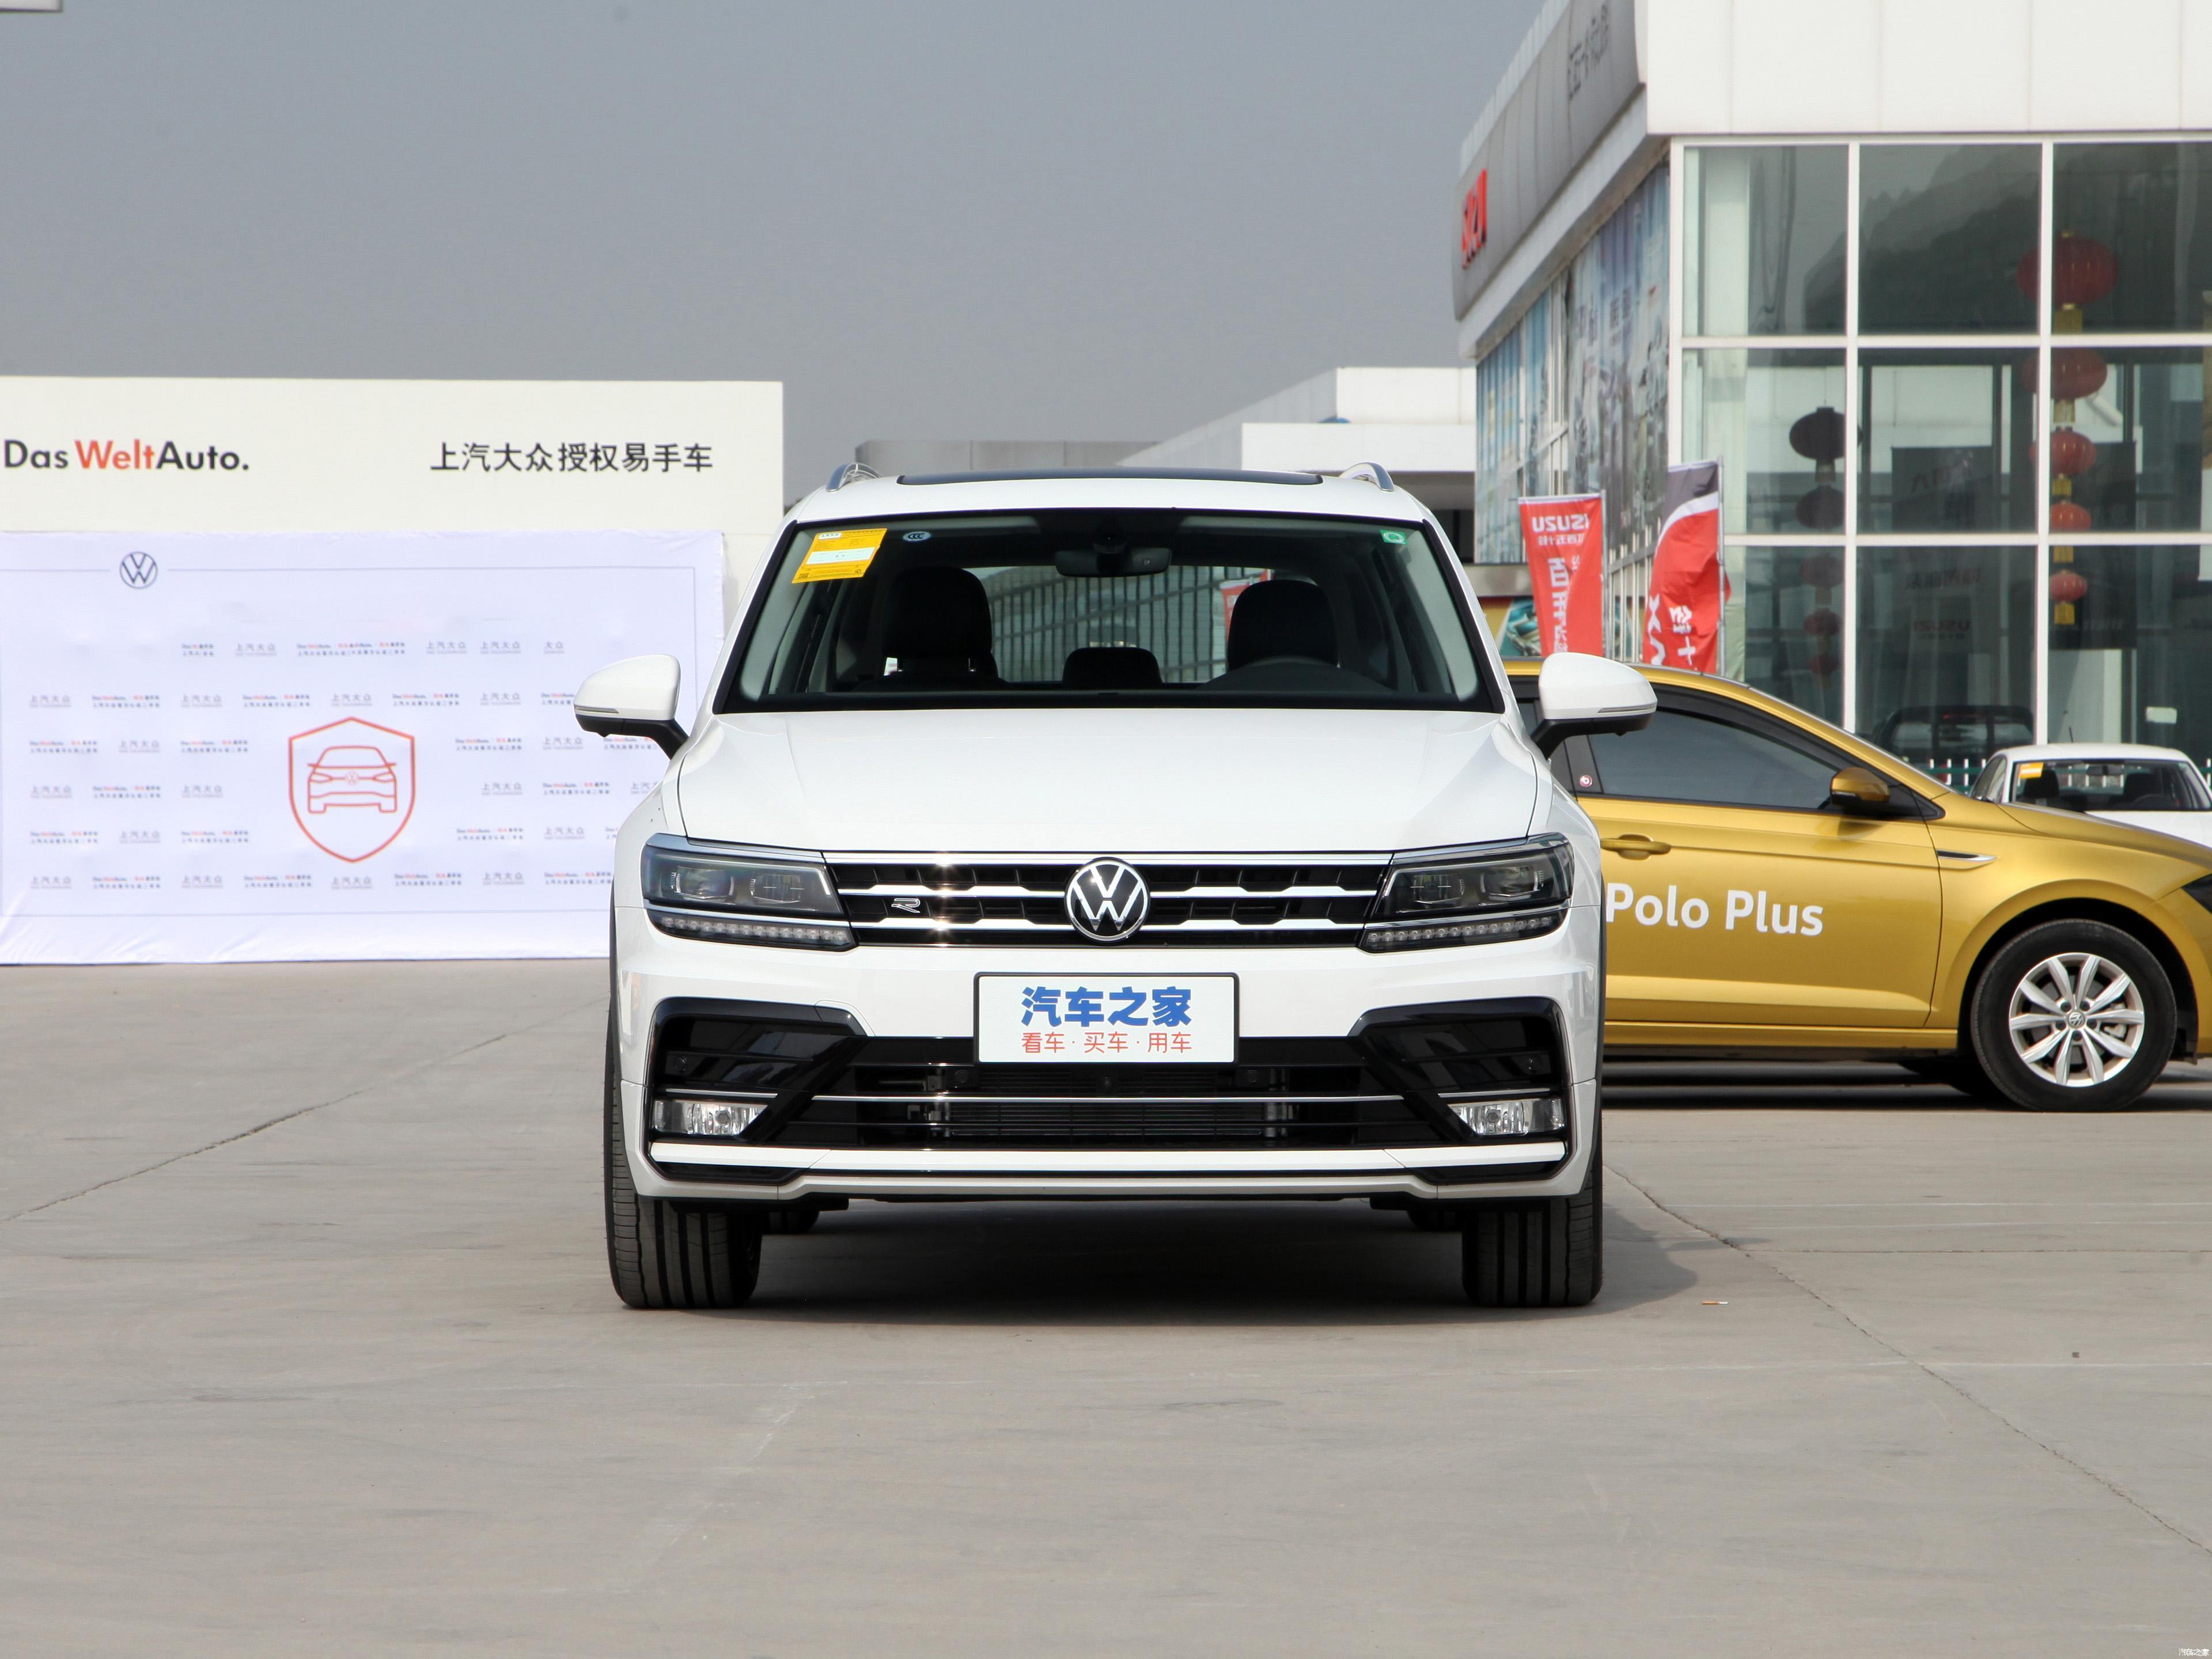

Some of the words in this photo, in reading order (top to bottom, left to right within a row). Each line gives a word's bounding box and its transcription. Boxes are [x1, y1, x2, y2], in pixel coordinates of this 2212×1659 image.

[3, 439, 69, 470] Das
[74, 438, 249, 472] WeltAuto.
[430, 442, 713, 473] 上汽大众授权易手车
[1606, 882, 1709, 929] Polo
[1725, 889, 1823, 936] Plus
[1022, 986, 1192, 1027] 汽车之家
